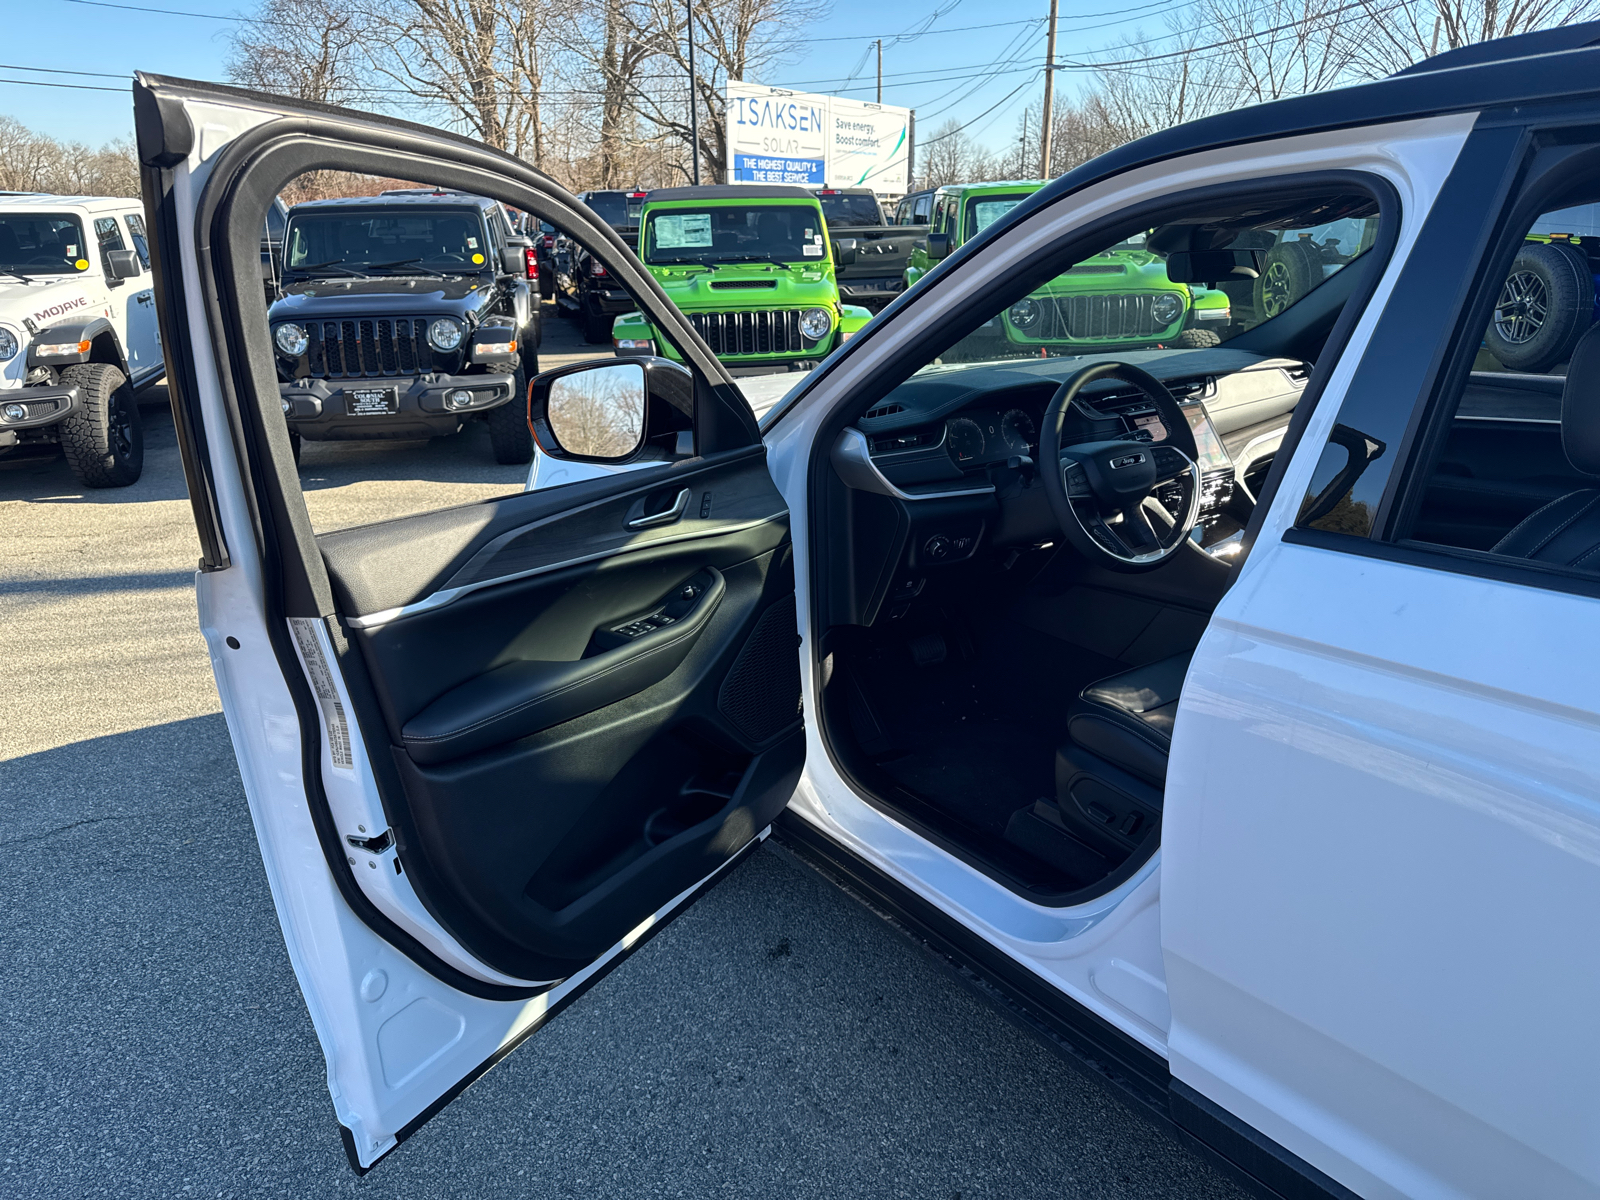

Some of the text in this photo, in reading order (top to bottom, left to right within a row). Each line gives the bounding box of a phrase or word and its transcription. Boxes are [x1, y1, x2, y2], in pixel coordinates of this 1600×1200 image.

[736, 97, 821, 133] ISAKSEN
[836, 118, 875, 135] Save energy.
[763, 137, 799, 154] SOLAR
[836, 133, 881, 148] Boost comfort.
[743, 158, 817, 172] THE HIGHEST QUALITY &
[752, 170, 809, 183] THE BEST SERVICE
[33, 297, 87, 322] MOJAVE
